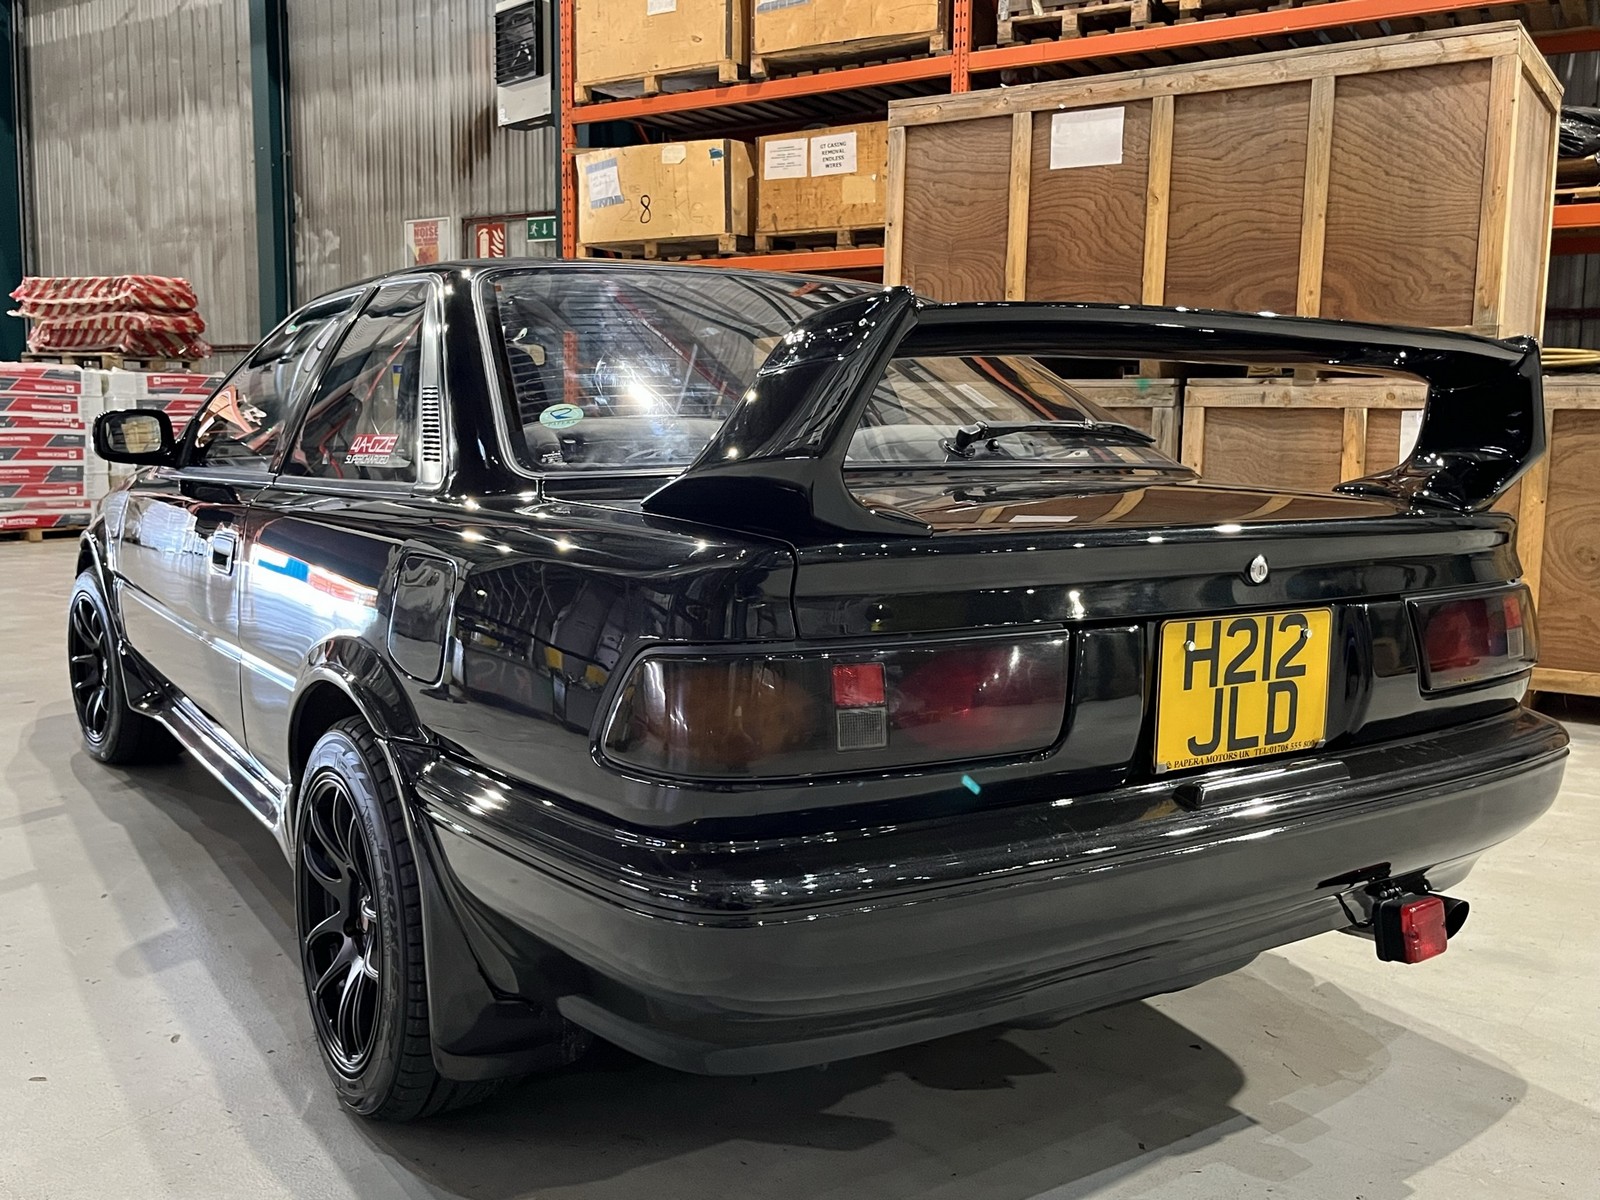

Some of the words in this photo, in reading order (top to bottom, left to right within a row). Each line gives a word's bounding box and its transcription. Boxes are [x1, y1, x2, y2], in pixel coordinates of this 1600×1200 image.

[821, 148, 846, 156] REMOVAL
[640, 194, 652, 223] 8
[414, 227, 438, 238] NOISE
[350, 436, 398, 453] 4A-GZE
[1184, 613, 1308, 690] H212
[1187, 680, 1298, 756] JLD
[1174, 757, 1205, 768] PAPERA
[1205, 751, 1238, 764] MOTORS
[1239, 750, 1250, 759] UK
[1289, 742, 1302, 751] 555
